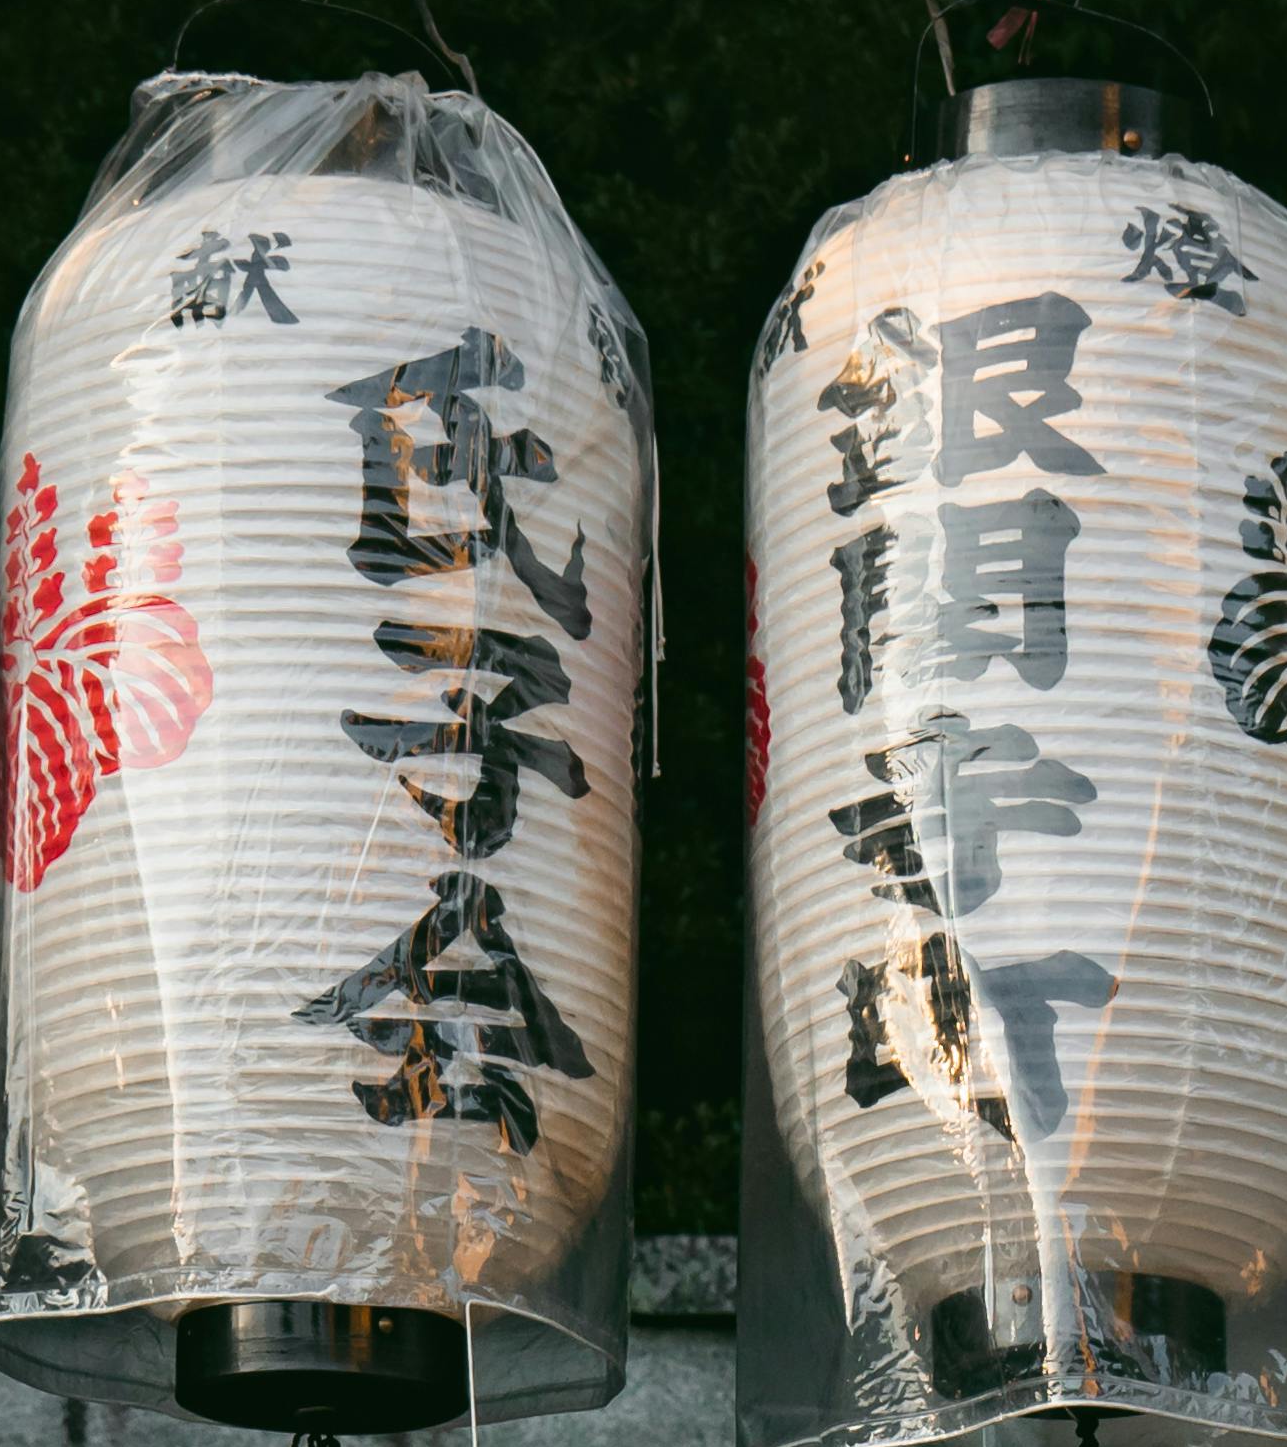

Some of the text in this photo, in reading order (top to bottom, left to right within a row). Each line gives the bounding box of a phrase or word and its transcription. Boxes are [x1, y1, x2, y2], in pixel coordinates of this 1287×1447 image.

[168, 231, 301, 329] 献
[1121, 203, 1260, 316] 燈
[291, 326, 595, 1155] 氏子会
[817, 291, 1118, 1145] 銀閣寺町
